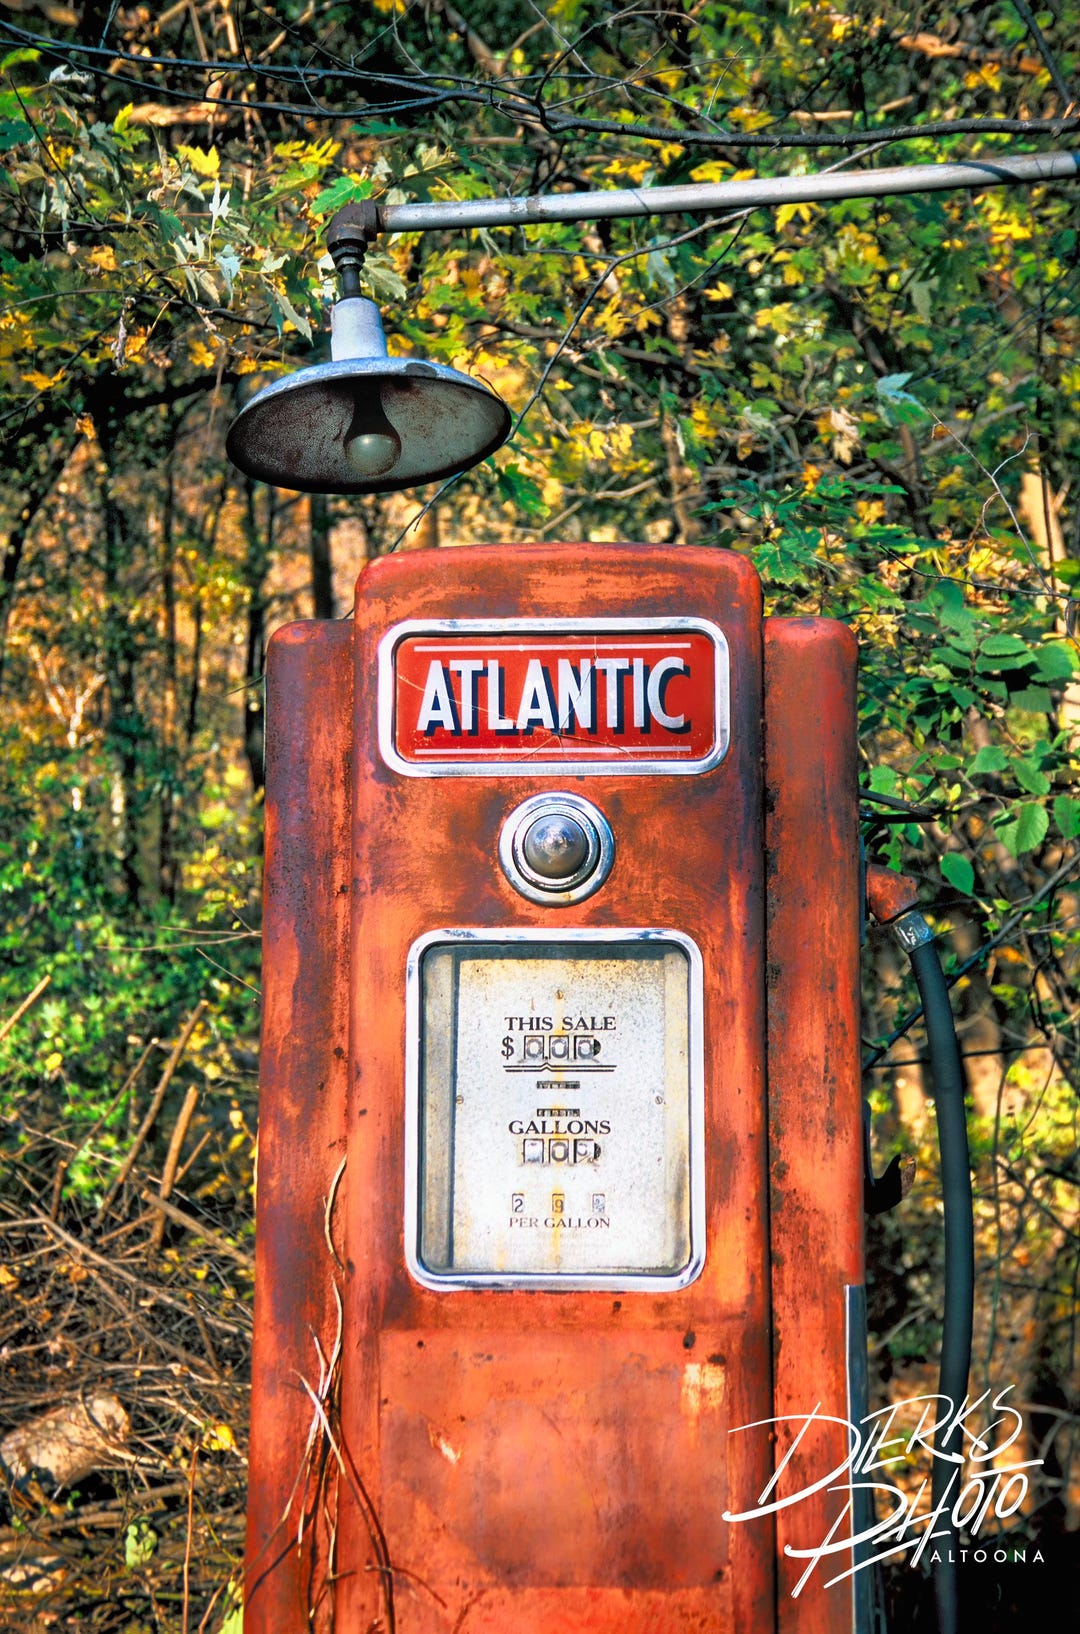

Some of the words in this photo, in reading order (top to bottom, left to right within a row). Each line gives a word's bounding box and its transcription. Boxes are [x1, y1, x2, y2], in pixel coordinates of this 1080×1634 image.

[416, 656, 691, 736] ATLANTIC
[504, 1016, 553, 1031] THIS
[562, 1016, 617, 1031] SALE
[508, 1120, 611, 1135] GALLONS
[509, 1217, 539, 1229] PER
[544, 1217, 610, 1229] GALLON
